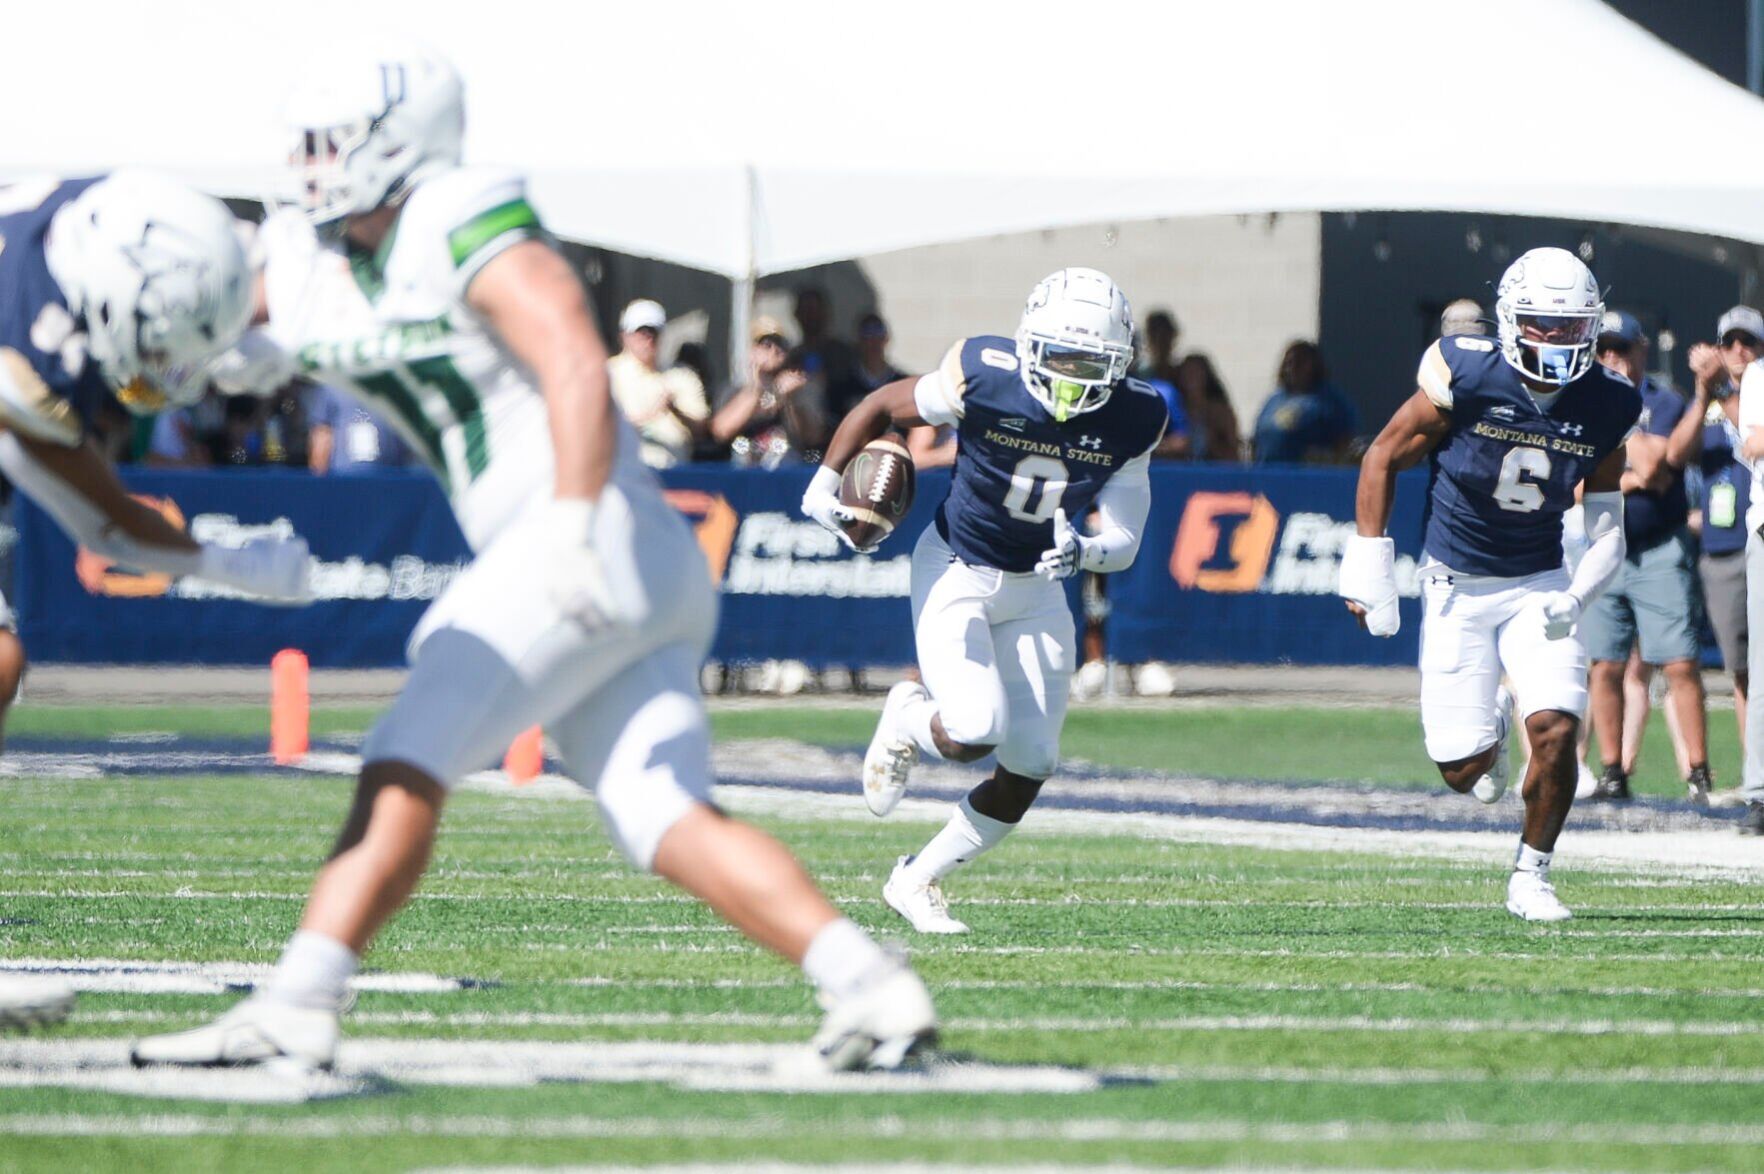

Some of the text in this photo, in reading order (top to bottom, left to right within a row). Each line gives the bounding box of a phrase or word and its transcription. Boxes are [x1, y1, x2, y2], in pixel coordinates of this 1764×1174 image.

[981, 348, 1019, 371] 0
[984, 430, 1113, 467] MONTANA STATE
[1473, 422, 1595, 458] MONTANA STATE
[1002, 454, 1070, 525] 0
[1493, 446, 1552, 514] 6
